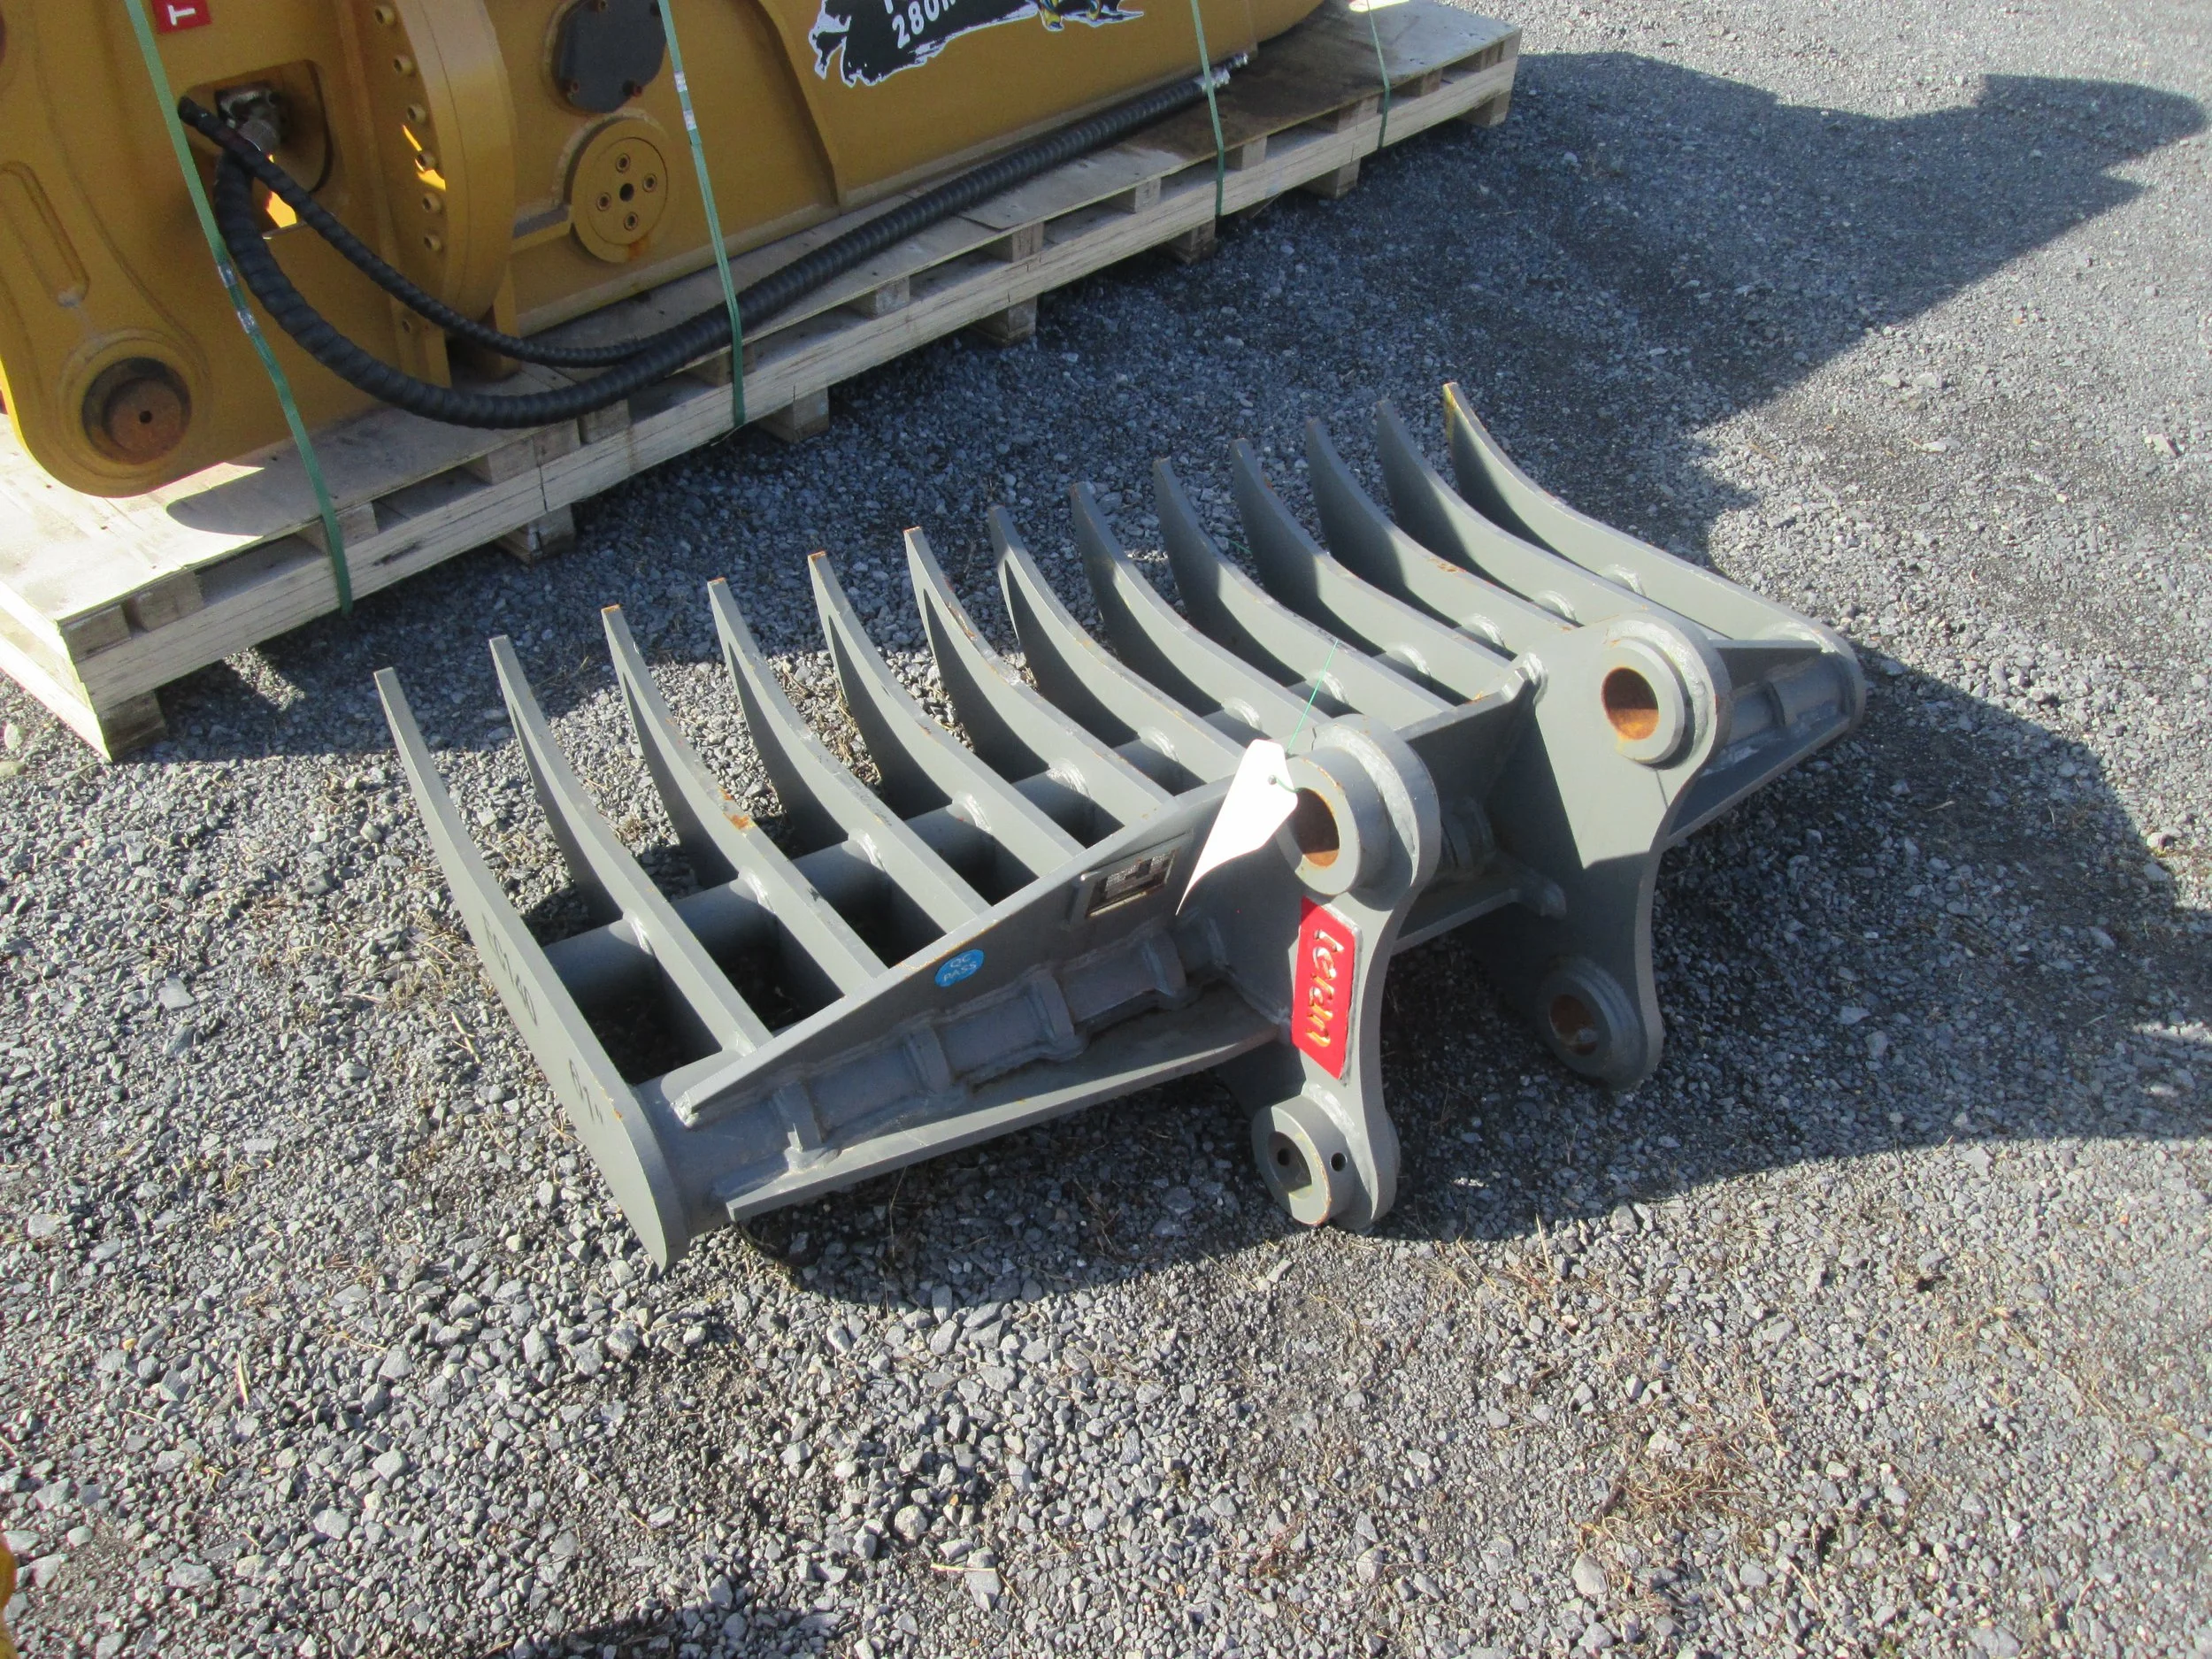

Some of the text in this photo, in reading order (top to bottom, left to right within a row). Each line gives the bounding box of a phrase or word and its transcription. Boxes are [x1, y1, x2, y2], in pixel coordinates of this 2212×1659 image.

[891, 0, 956, 49] 280
[480, 910, 539, 1027] EC140
[943, 961, 977, 982] PASS
[950, 953, 972, 968] QC
